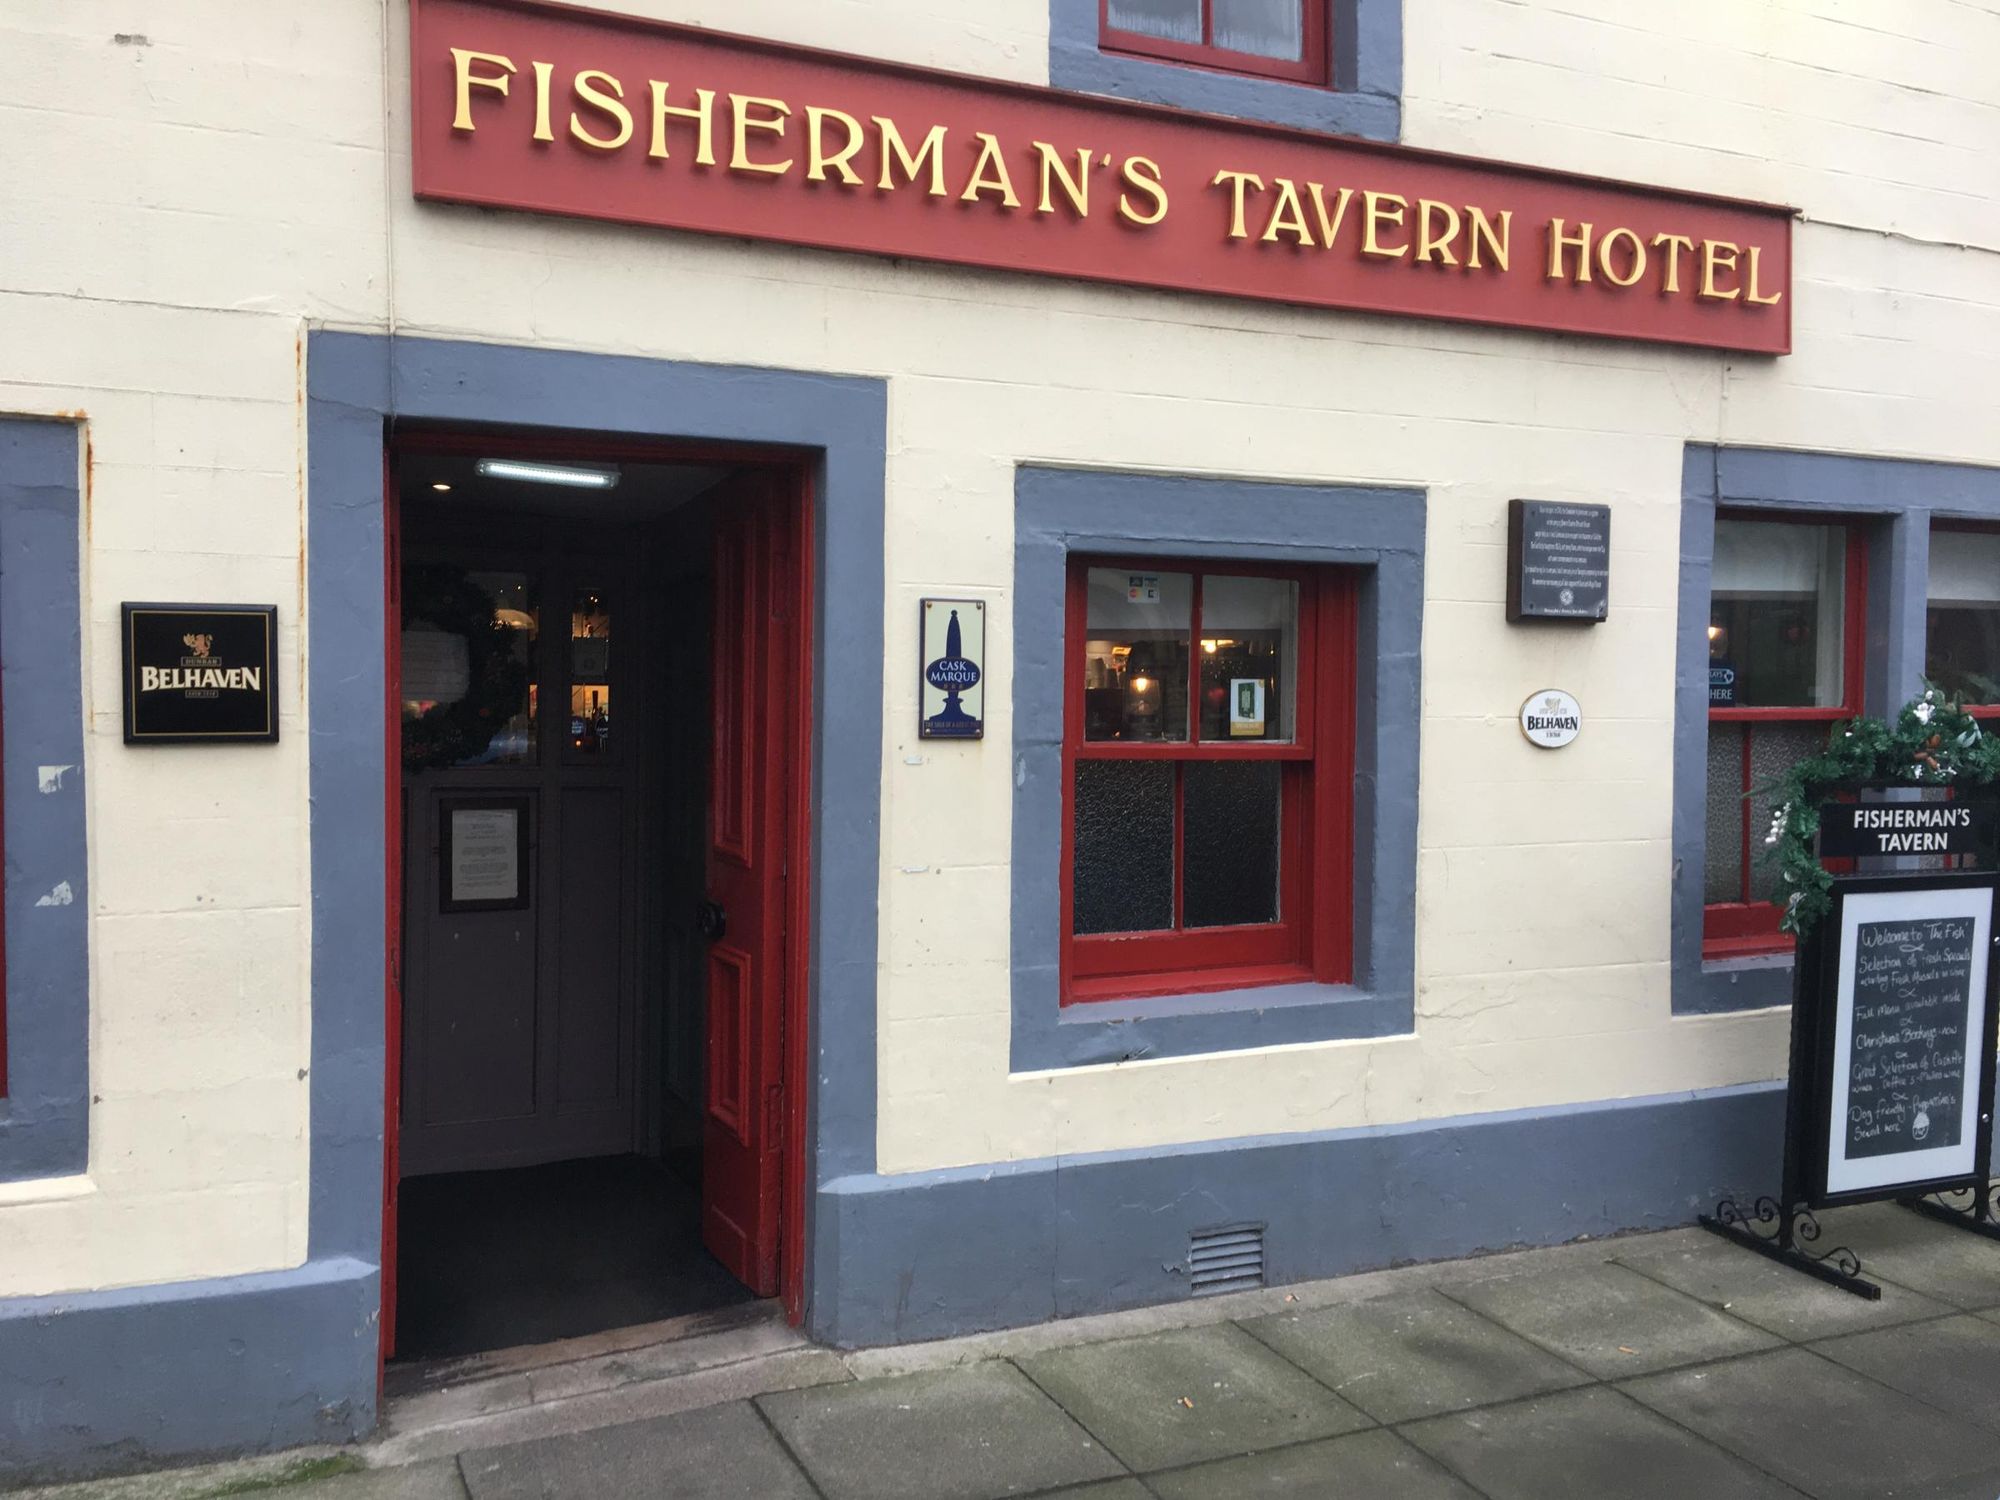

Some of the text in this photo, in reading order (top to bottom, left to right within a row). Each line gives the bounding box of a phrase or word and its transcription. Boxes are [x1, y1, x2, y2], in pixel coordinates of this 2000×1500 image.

[450, 47, 1783, 305] FISHERMAN'S TAVERN HOTEL
[939, 660, 966, 671] CASK
[141, 666, 261, 692] BELHAVEN
[931, 671, 977, 682] MARQUE
[1710, 688, 1733, 700] HERE
[1527, 715, 1578, 731] BELHAVEN
[1853, 808, 1970, 829] FISHERMAN'S
[1877, 832, 1948, 852] TAVERN
[1861, 927, 1910, 948] Welcome
[1910, 927, 1924, 941] to
[1859, 955, 1902, 974] Selection
[1848, 1105, 1873, 1126] Dog
